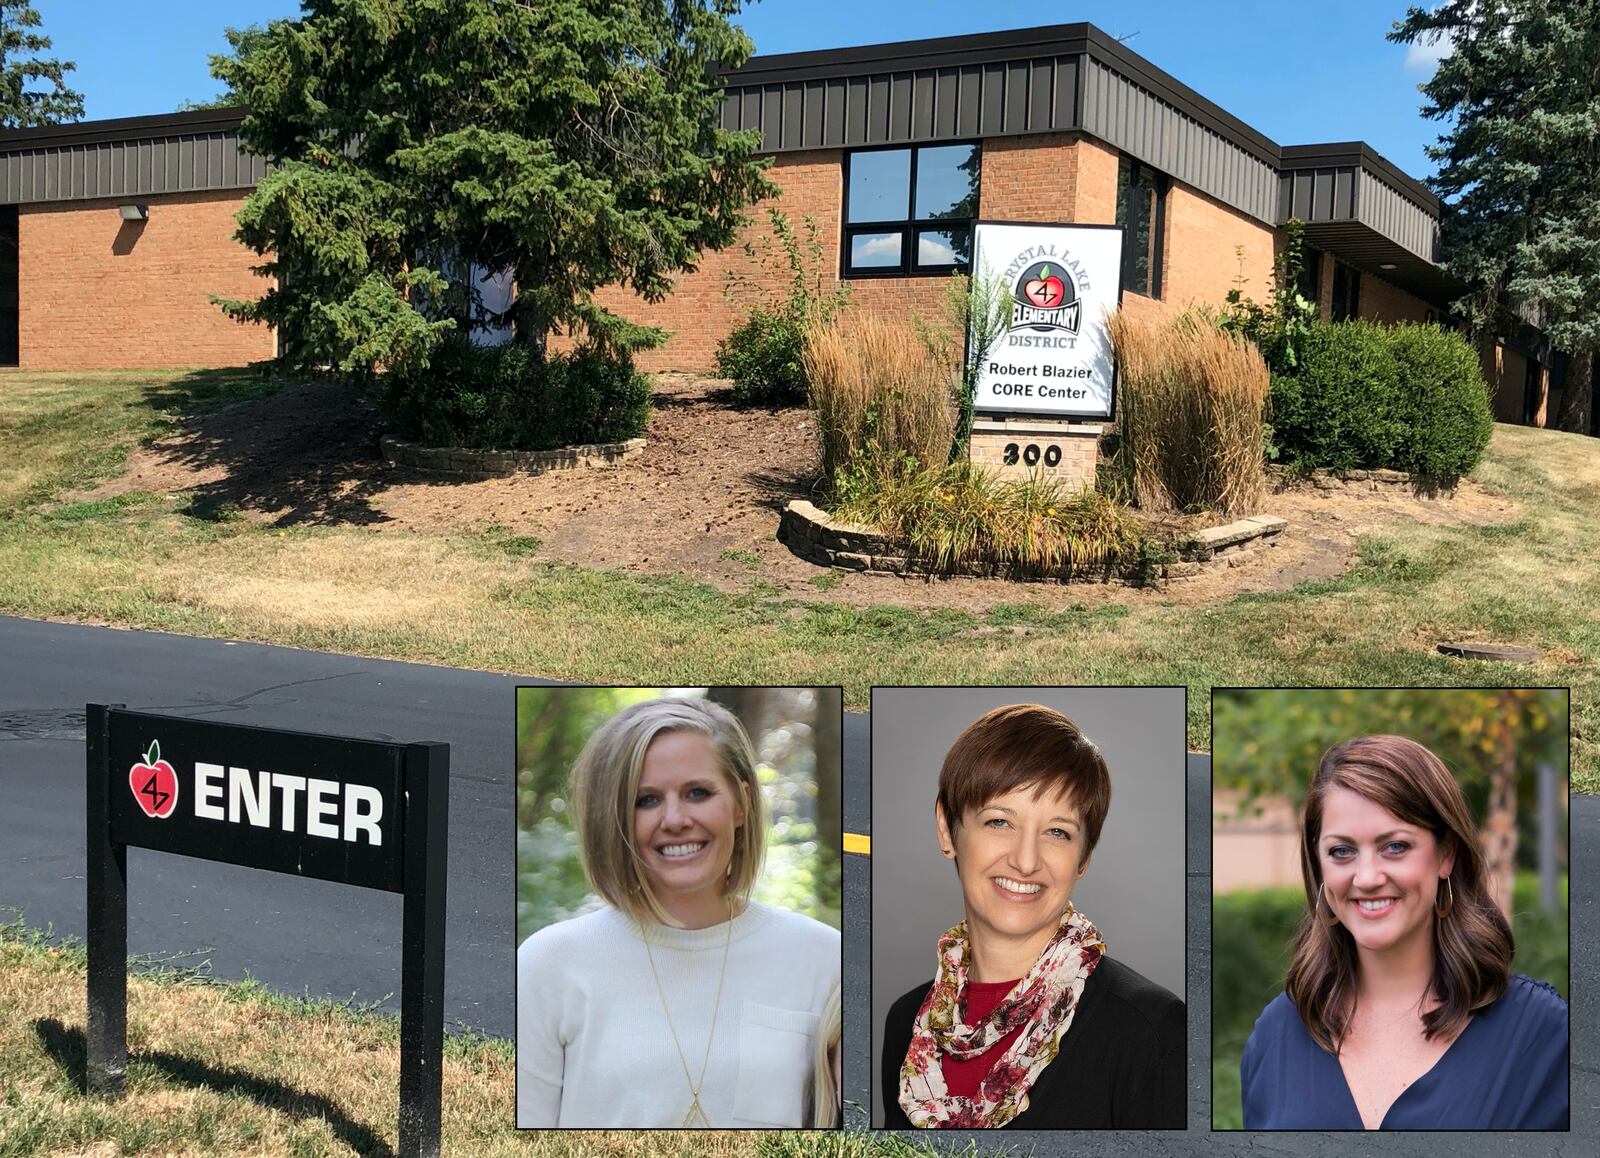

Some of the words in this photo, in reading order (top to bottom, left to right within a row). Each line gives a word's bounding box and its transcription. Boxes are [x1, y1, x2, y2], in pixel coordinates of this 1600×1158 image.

[1060, 250, 1091, 292] LAKE
[1011, 302, 1078, 331] ELEMENTARY
[1008, 335, 1077, 349] DISTRICT
[989, 362, 1038, 376] Robert
[1042, 365, 1093, 379] Blazier
[992, 383, 1034, 397] CORE
[1038, 385, 1087, 399] Center
[1003, 443, 1063, 468] 300
[194, 761, 384, 847] ENTER
